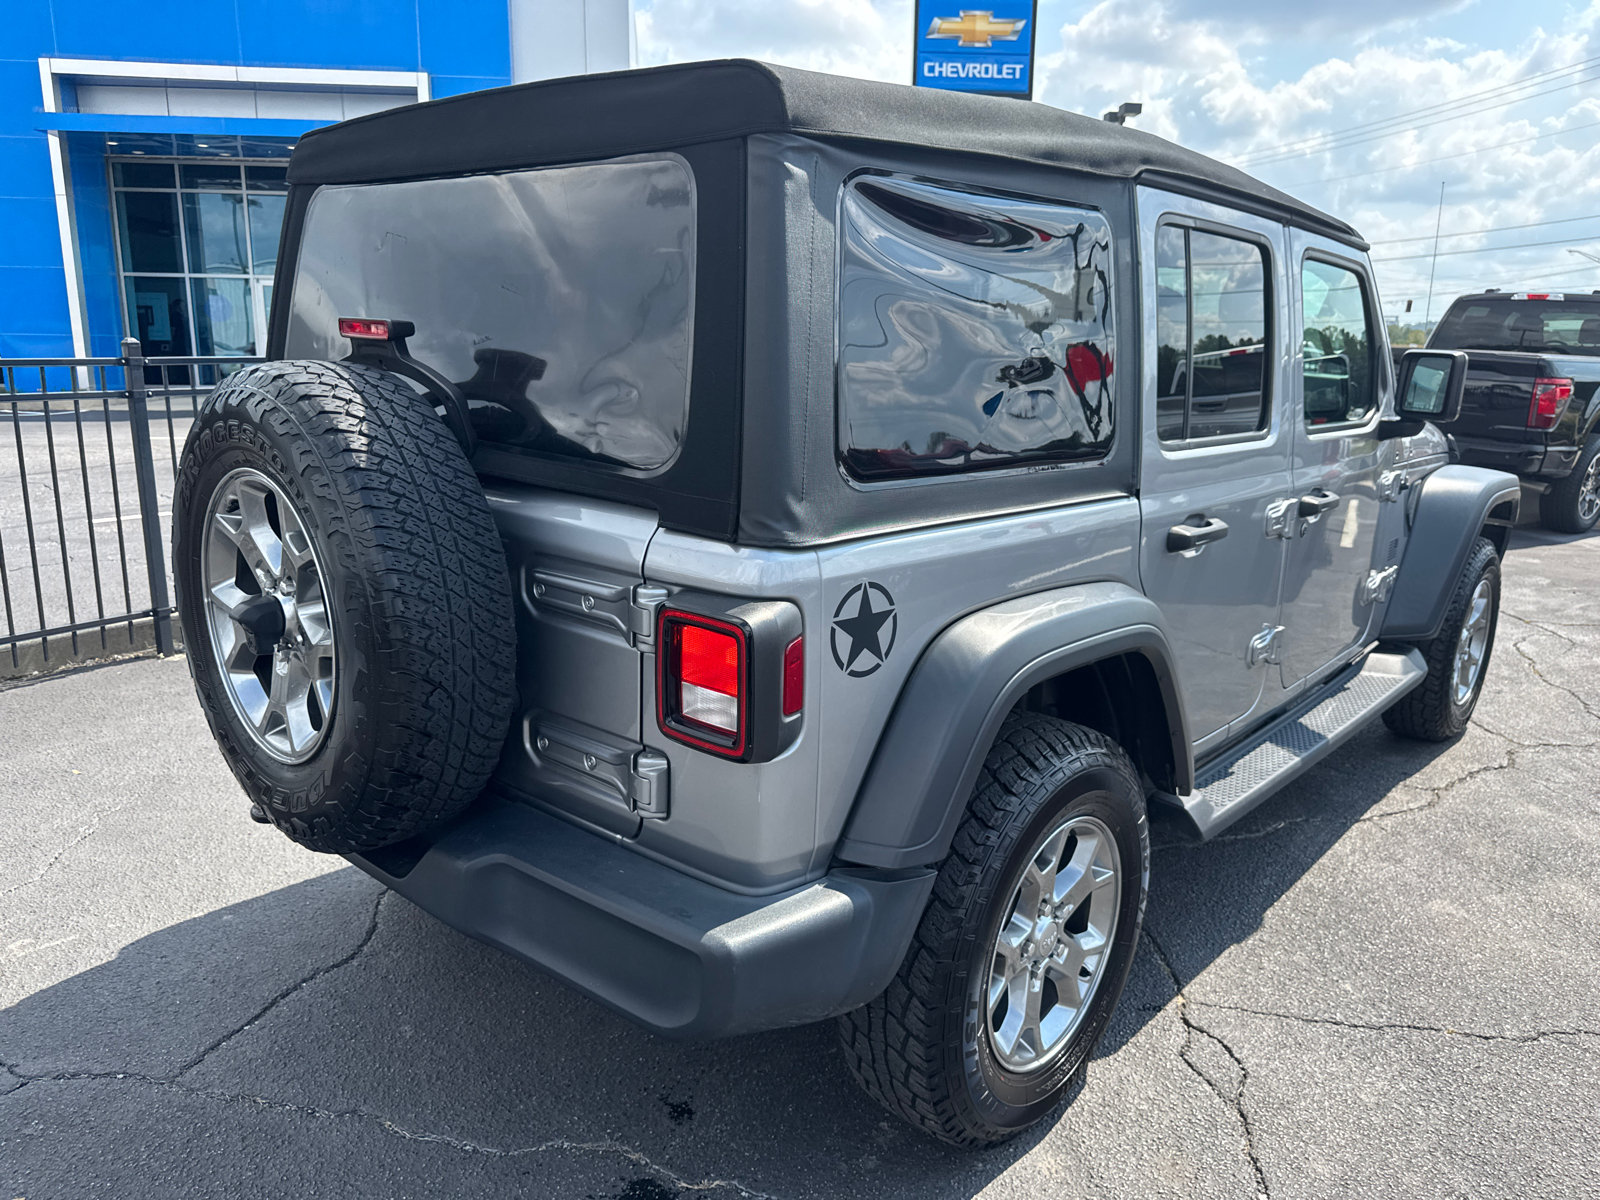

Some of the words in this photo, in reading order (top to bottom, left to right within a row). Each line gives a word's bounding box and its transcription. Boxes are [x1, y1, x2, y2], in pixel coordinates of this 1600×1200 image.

[923, 61, 1024, 79] CHEVROLET
[179, 418, 319, 529] BRIDGESTONE
[218, 726, 327, 814] DUELER
